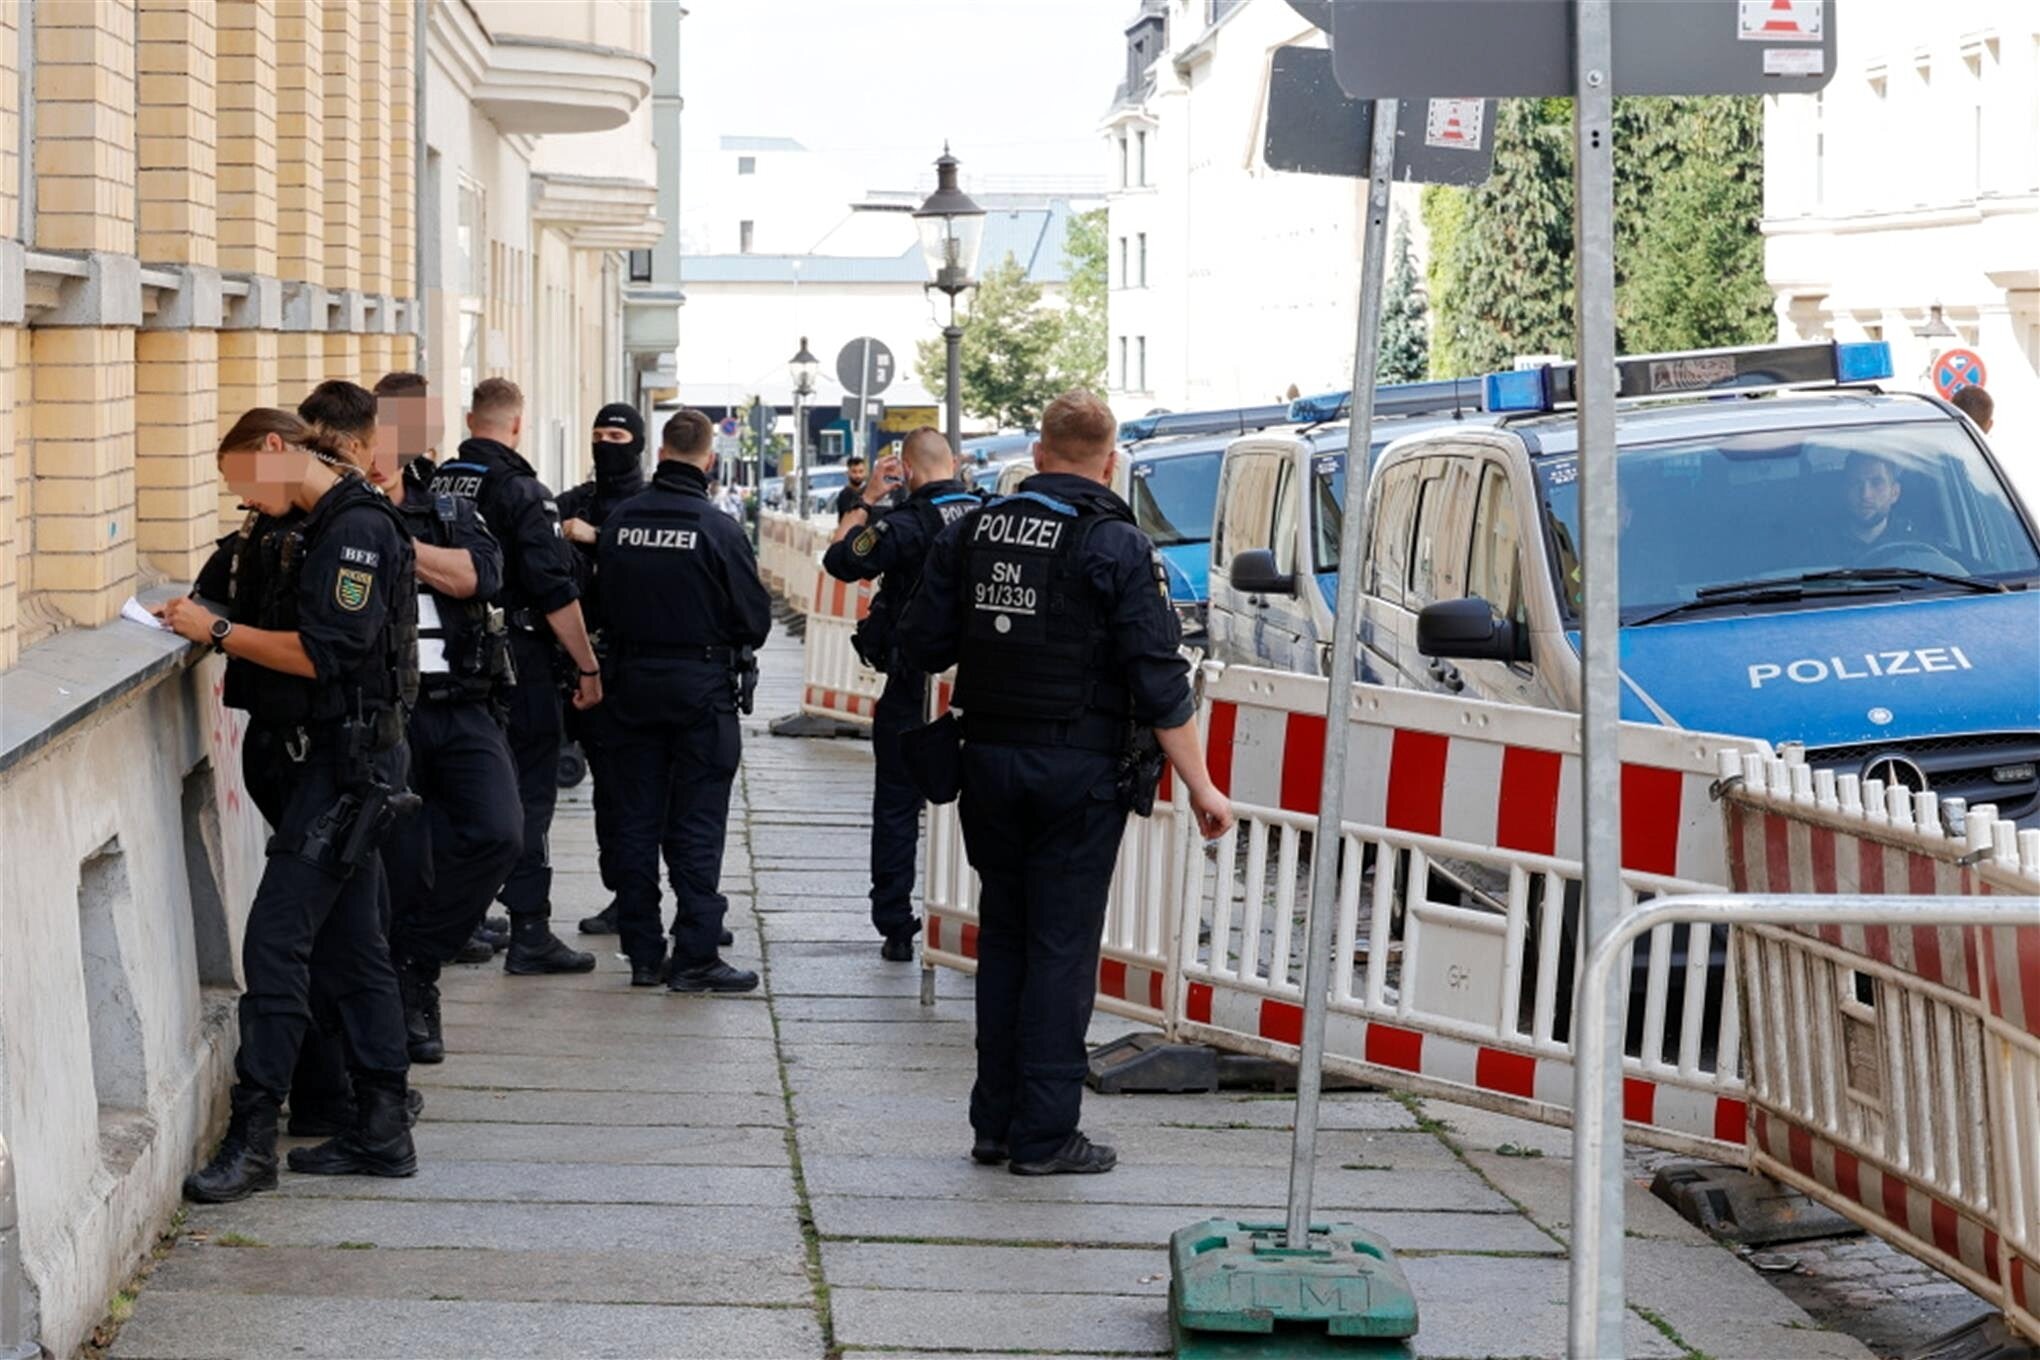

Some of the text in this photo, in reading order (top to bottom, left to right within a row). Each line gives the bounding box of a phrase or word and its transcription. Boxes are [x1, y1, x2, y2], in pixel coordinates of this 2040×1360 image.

[428, 476, 483, 497] POLIZEI
[616, 527, 698, 550] POLIZEI
[974, 513, 1063, 549] POLIZEI
[991, 561, 1022, 584] SN
[975, 582, 1036, 608] 91/330
[1748, 646, 1973, 689] POLIZEI
